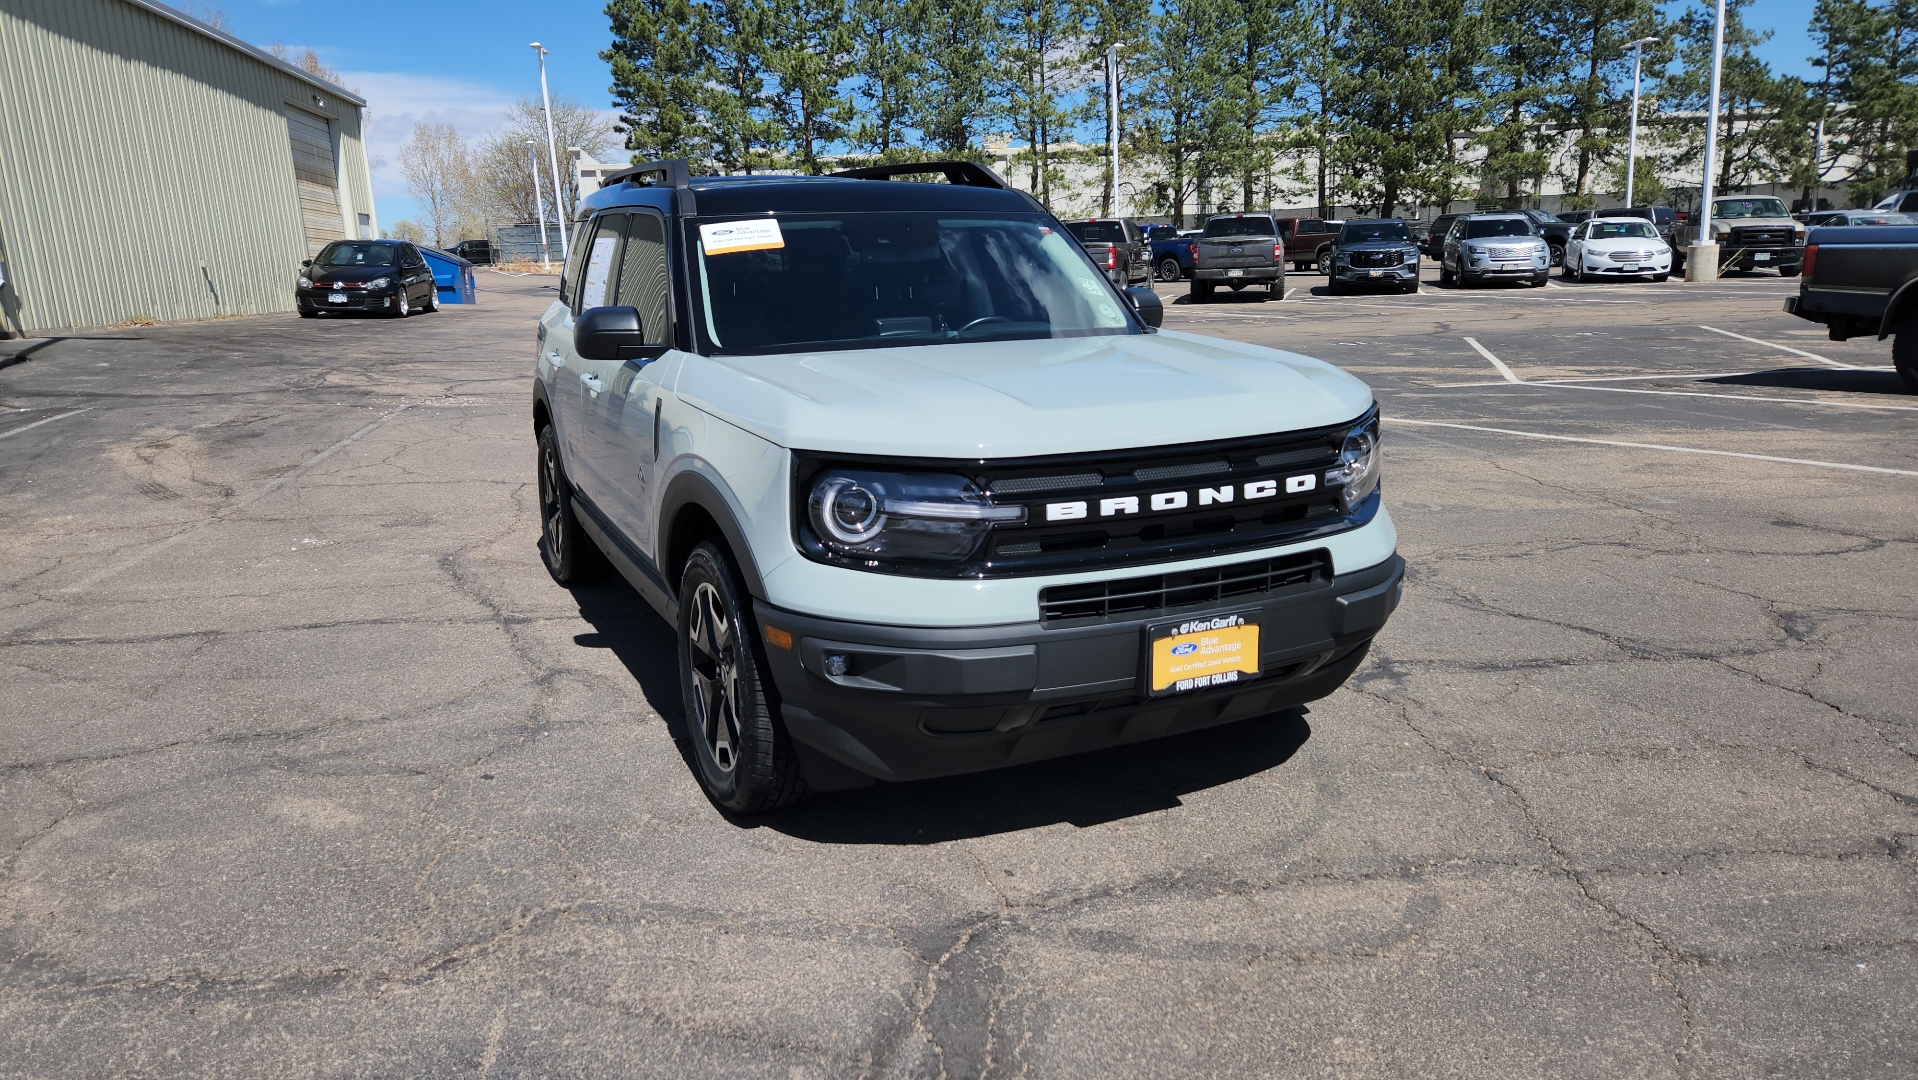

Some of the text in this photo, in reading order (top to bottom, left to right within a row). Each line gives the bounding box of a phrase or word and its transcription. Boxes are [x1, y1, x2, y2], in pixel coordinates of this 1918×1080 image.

[1046, 474, 1316, 521] BRONCO
[1190, 615, 1237, 632] Ken Garff
[1200, 642, 1241, 654] Advantage
[1201, 637, 1218, 645] Blue
[1173, 643, 1195, 655] Ford
[1183, 661, 1206, 670] Certified
[1222, 655, 1241, 663] Vehicle
[1176, 671, 1238, 691] FORD FORT COLLINS
